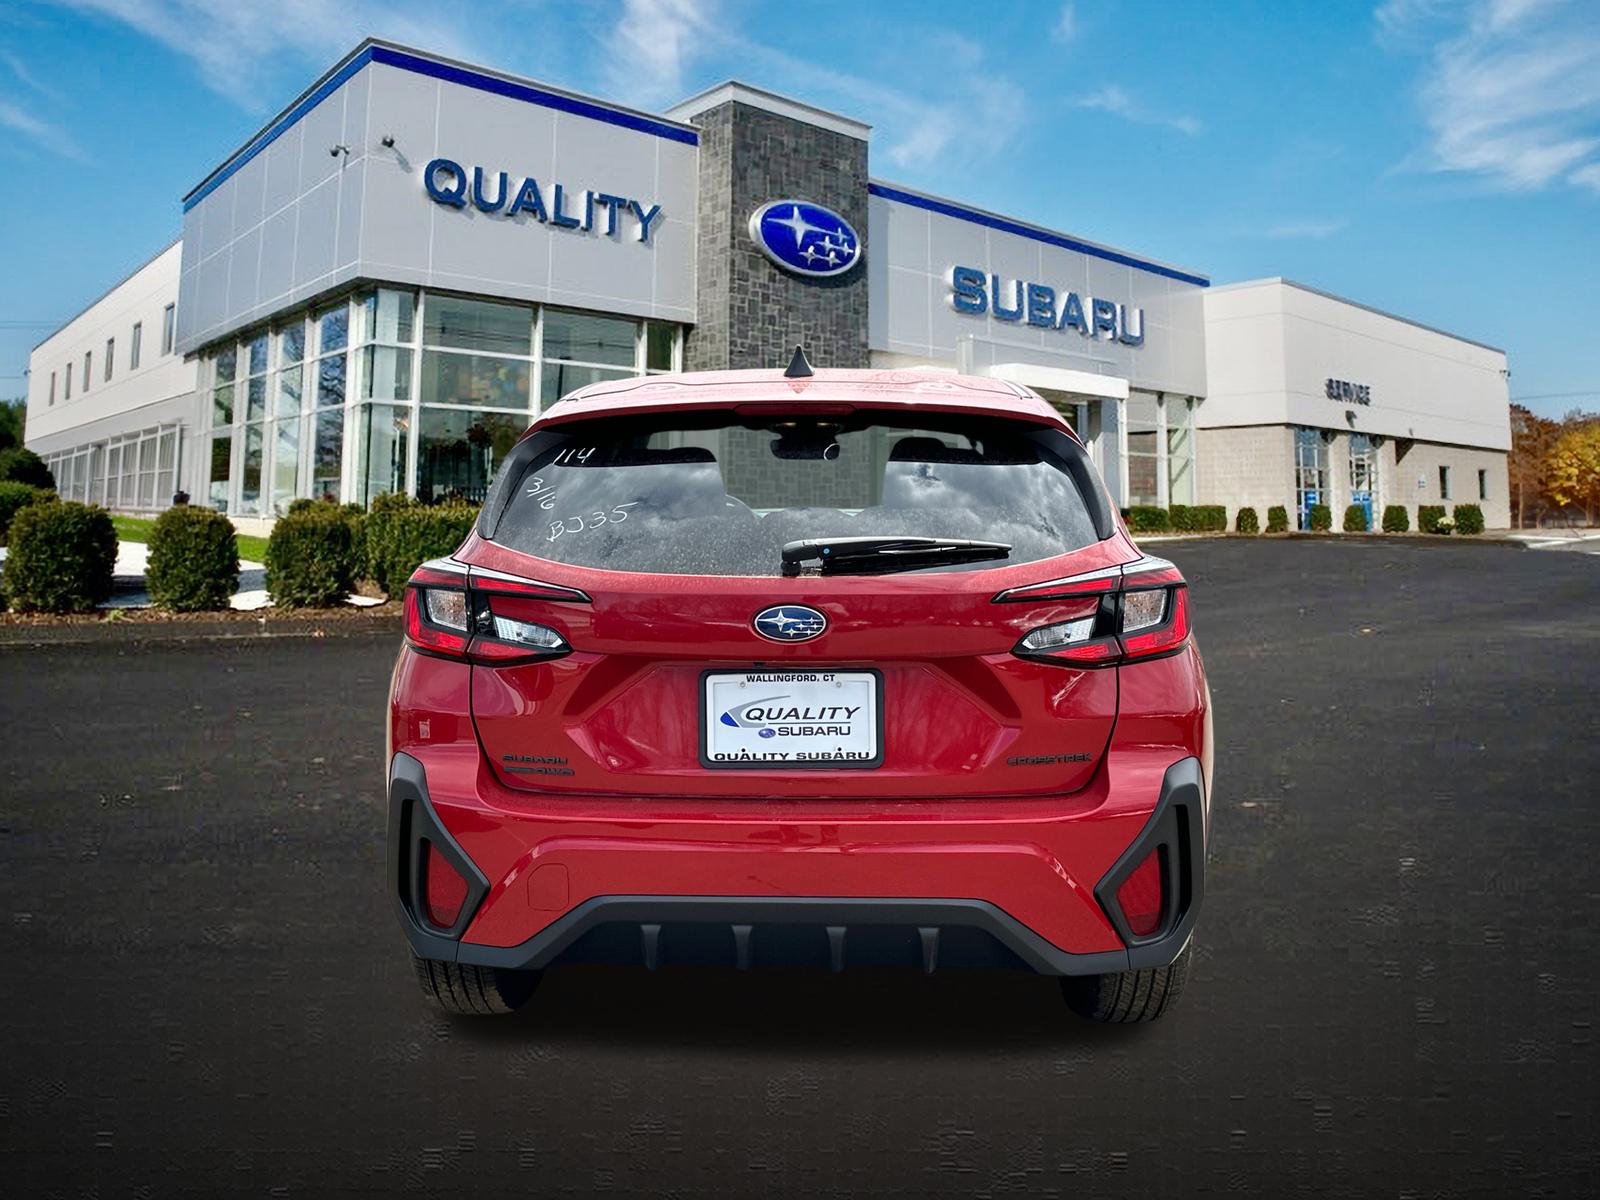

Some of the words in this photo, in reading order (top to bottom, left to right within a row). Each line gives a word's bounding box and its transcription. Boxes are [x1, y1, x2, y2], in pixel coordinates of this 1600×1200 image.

[424, 158, 662, 242] QUALITY
[948, 265, 1145, 346] SUBARU
[552, 447, 596, 464] 114
[823, 674, 836, 682] CT
[745, 706, 861, 721] QUALITY
[777, 726, 851, 737] SUBARU
[503, 754, 568, 764] SUBARU
[714, 752, 790, 761] QUALITY
[796, 751, 870, 760] SUBARU
